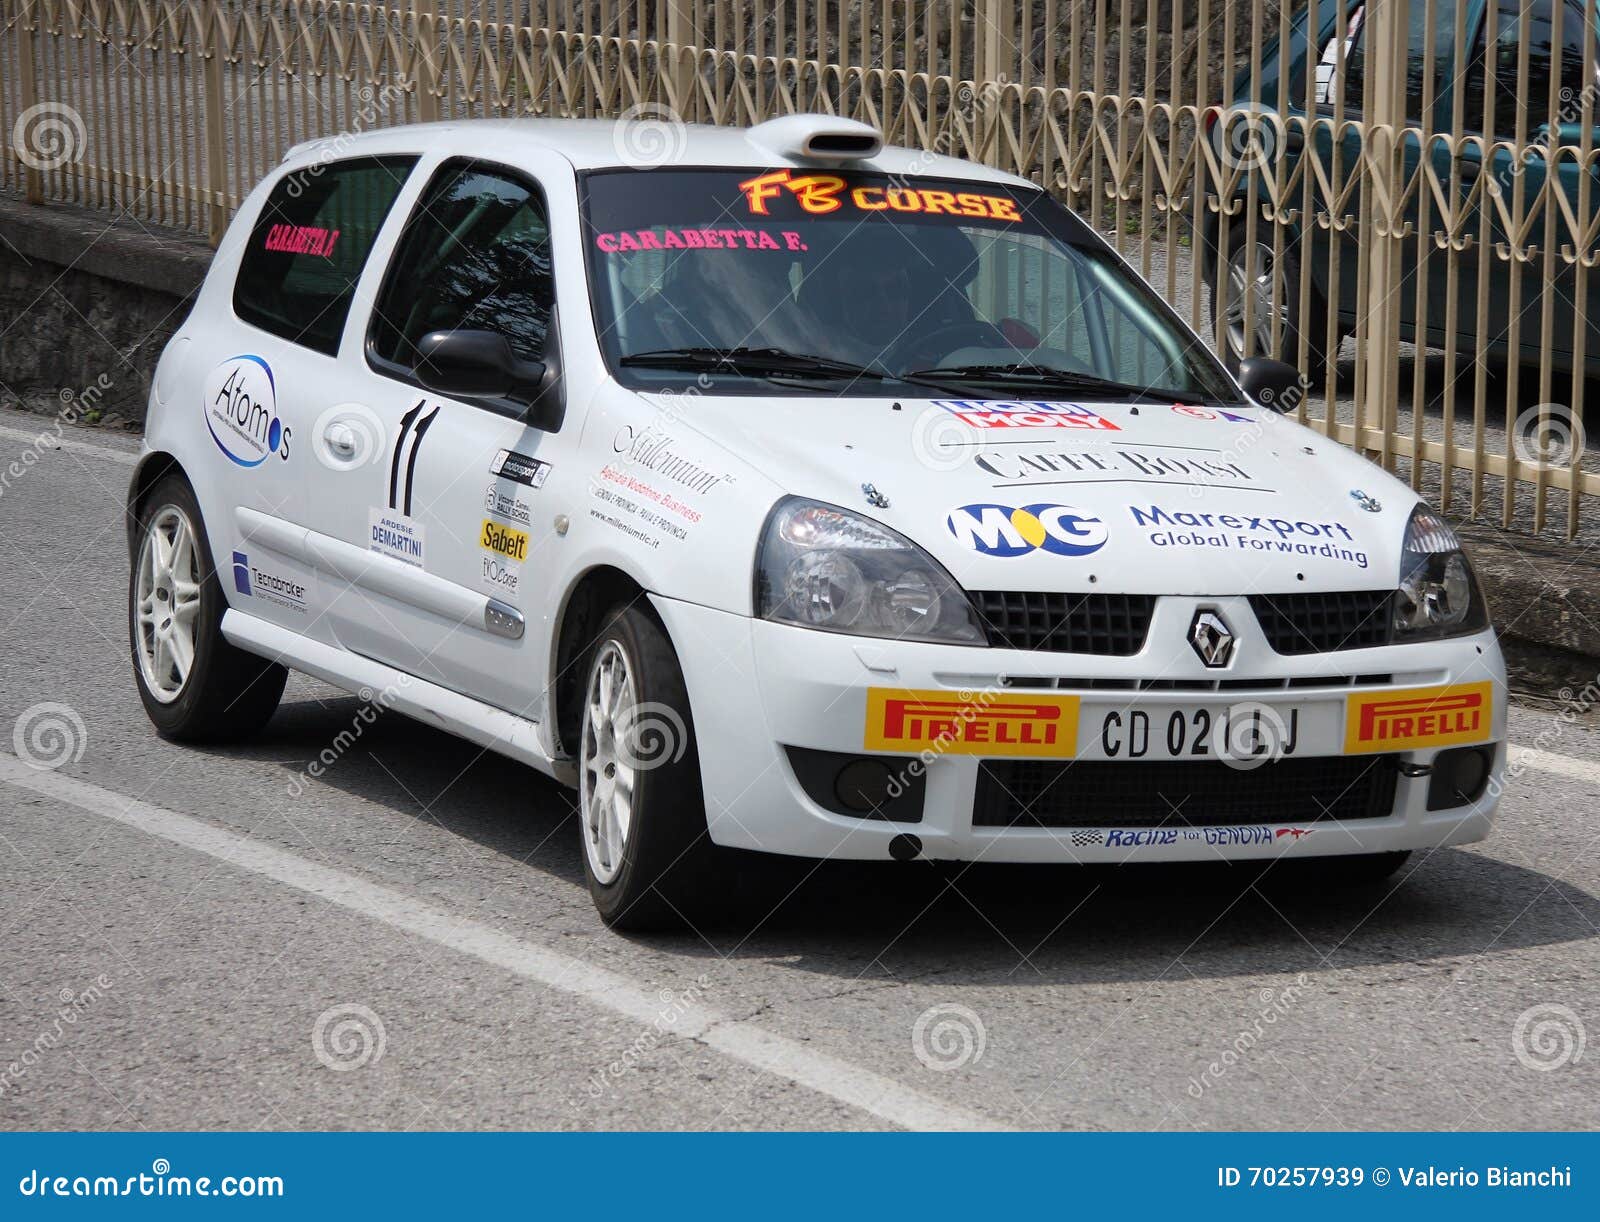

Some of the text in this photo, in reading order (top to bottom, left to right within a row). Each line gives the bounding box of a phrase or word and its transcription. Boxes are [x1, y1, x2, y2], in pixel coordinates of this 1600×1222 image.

[739, 169, 1023, 222] FB CORSE
[265, 223, 329, 256] CARABETTA
[596, 230, 808, 253] CARABETTA F.
[936, 400, 1095, 415] LIQUI
[967, 412, 1110, 429] MOLY
[389, 399, 441, 517] 11
[660, 493, 702, 524] Business
[1128, 505, 1355, 541] Marexport
[372, 525, 422, 557] DEMARTINI
[381, 518, 413, 535] ARDESIE
[483, 523, 525, 559] Sabelt
[1150, 531, 1369, 568] Global Forwarding
[252, 567, 306, 600] Tecnobroker
[884, 700, 1062, 745] PIRELLI
[1358, 692, 1483, 742] PIRELLI
[1102, 711, 1149, 757] CD
[1105, 827, 1273, 847] Racing for GENOVA
